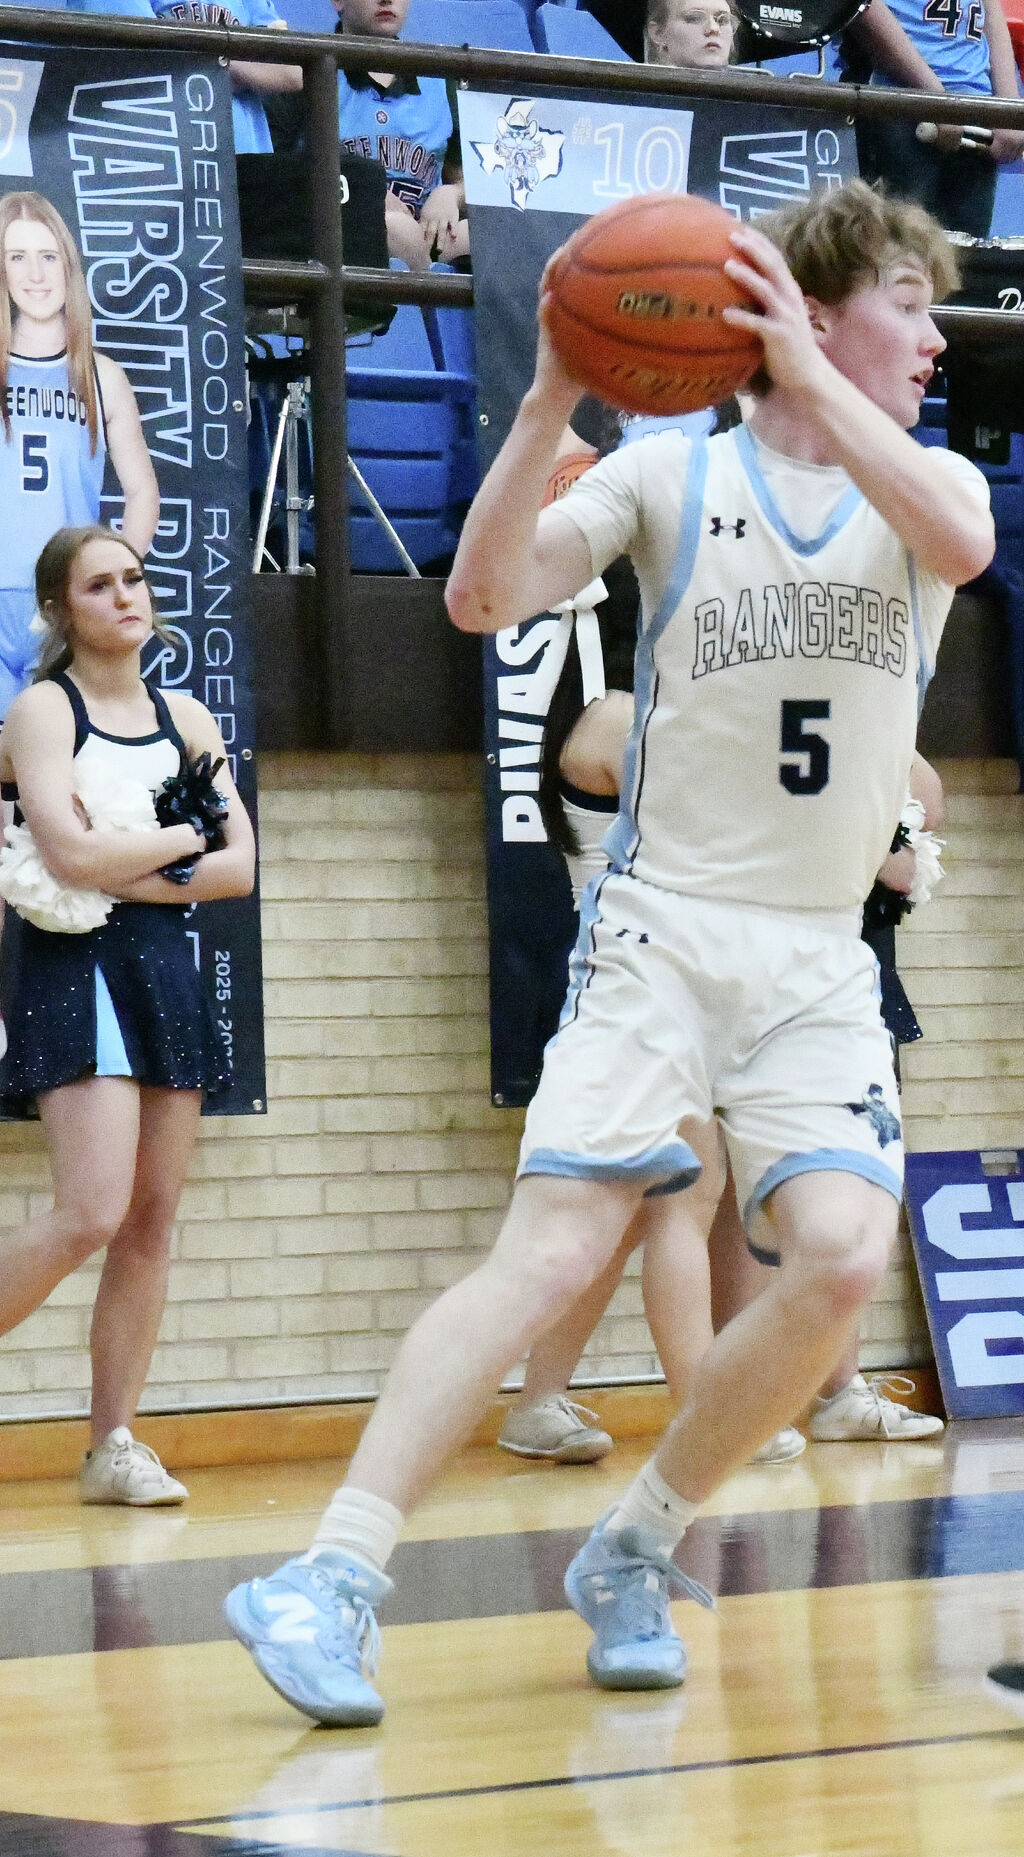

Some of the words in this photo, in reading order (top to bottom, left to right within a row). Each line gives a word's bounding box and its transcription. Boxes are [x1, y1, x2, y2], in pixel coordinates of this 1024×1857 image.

[759, 4, 803, 23] EVANS
[67, 74, 192, 468] VARSITY
[185, 73, 229, 461] GREENWOOD
[22, 433, 50, 492] 5
[691, 581, 909, 681] RANGERS
[778, 698, 832, 796] 5
[214, 949, 232, 1001] 2025
